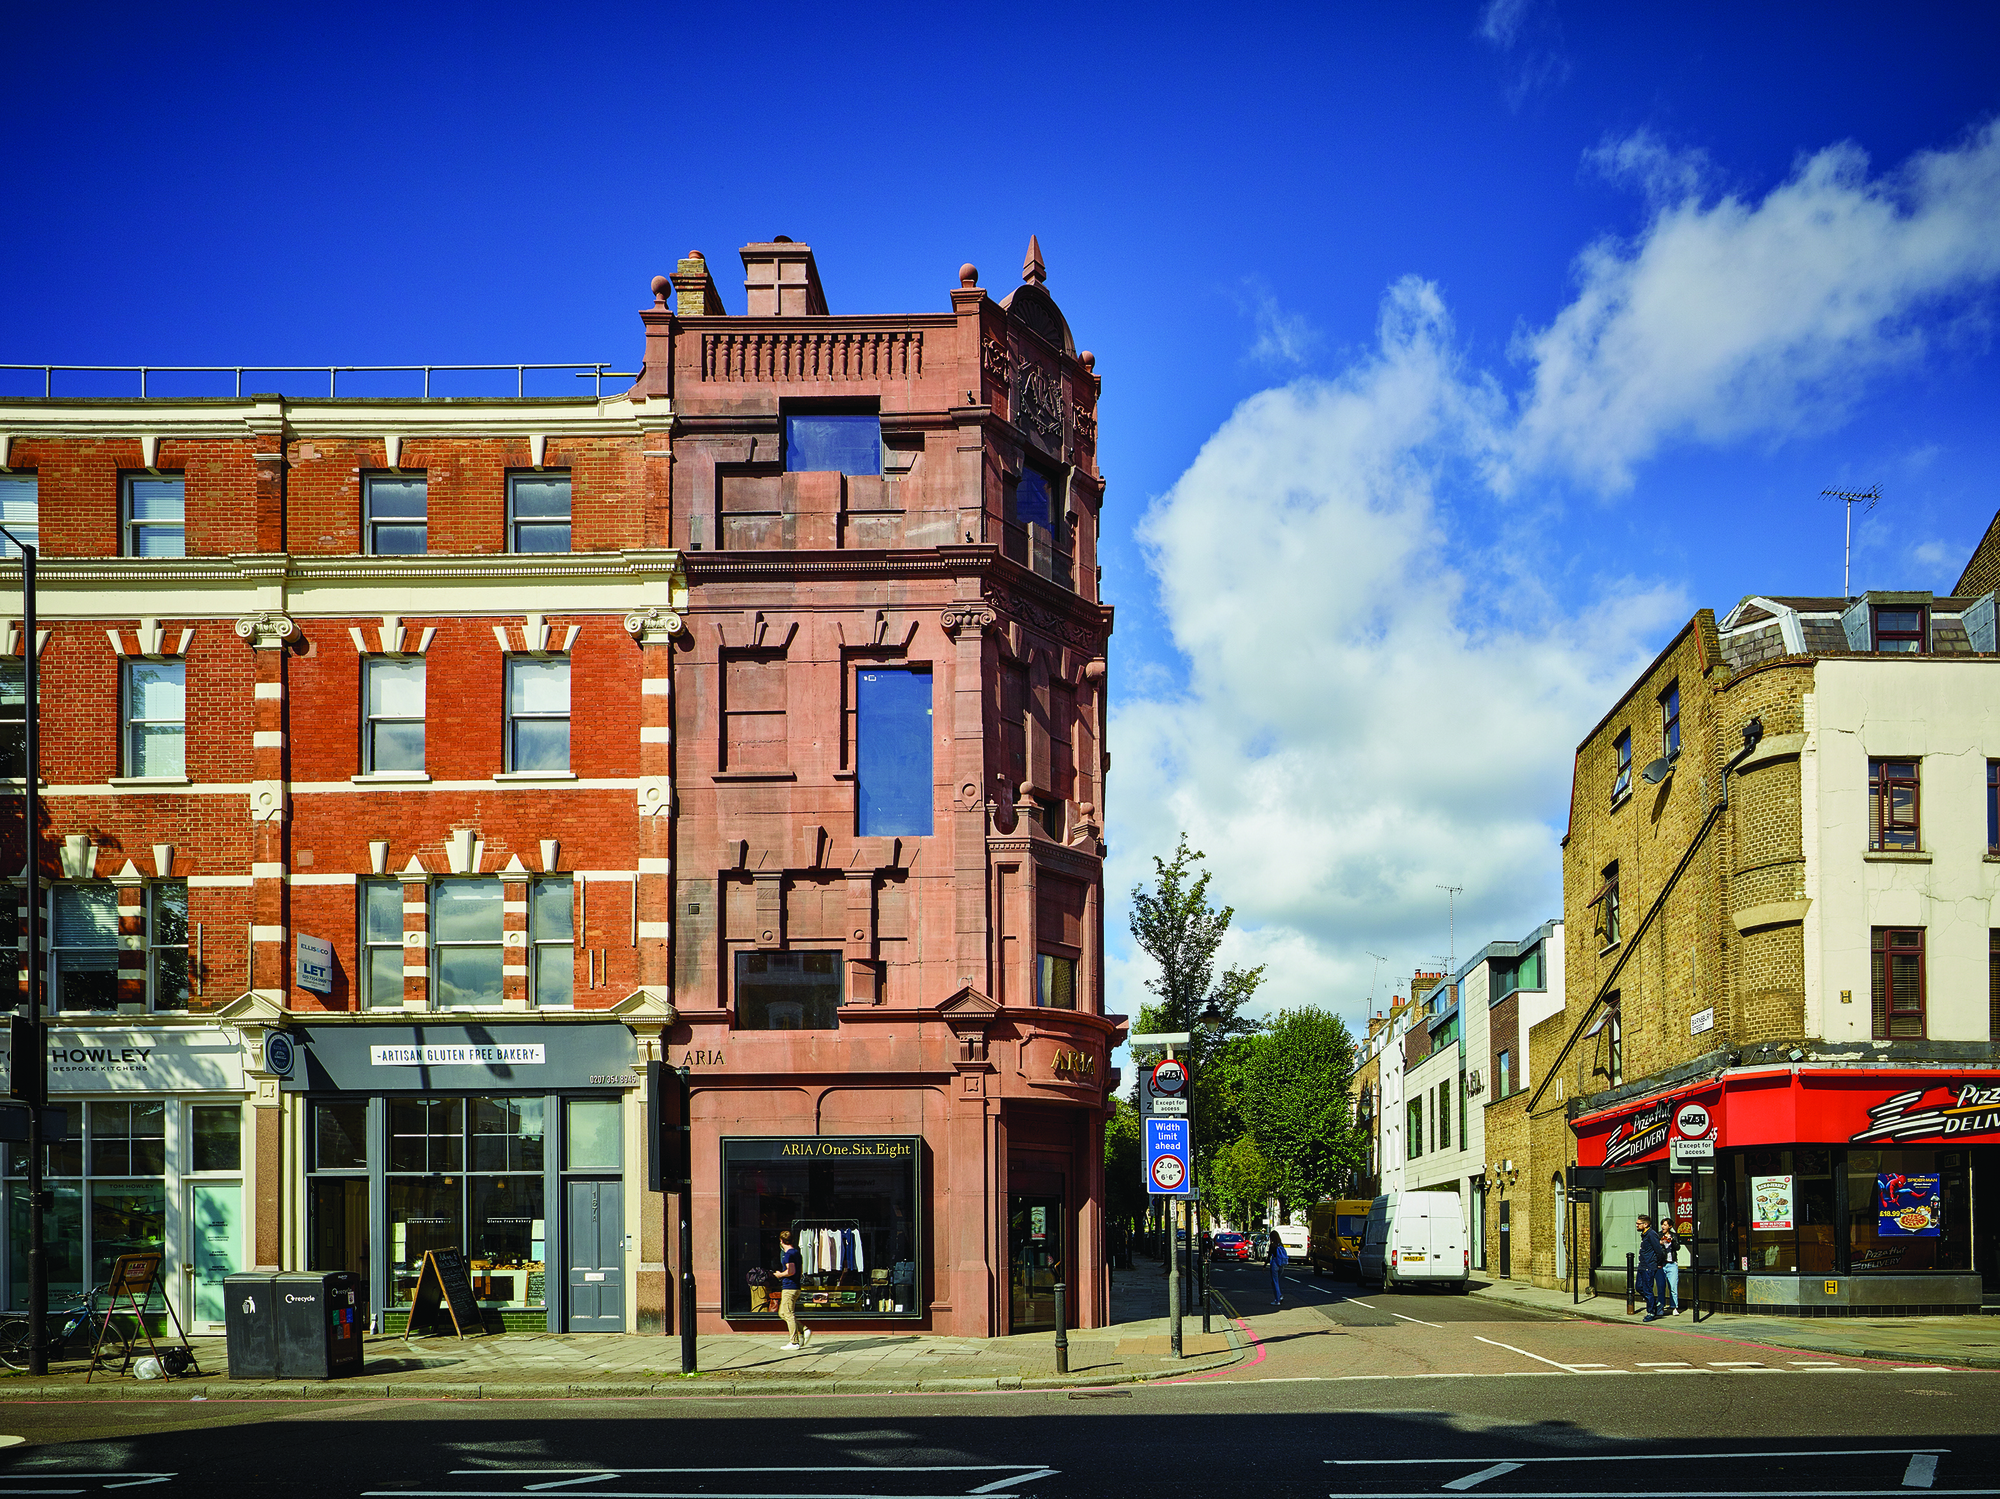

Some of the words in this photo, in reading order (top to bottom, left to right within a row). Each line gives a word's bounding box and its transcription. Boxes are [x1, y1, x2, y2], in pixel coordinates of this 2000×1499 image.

[301, 943, 329, 956] ELLIS&CO
[304, 963, 326, 977] LET
[1692, 1013, 1712, 1026] BARNSBURY
[52, 1049, 151, 1063] HOWLEY
[427, 1050, 465, 1061] GLUTEN
[470, 1049, 493, 1060] FREE
[682, 1049, 727, 1066] ARIA
[1050, 1048, 1096, 1075] ARIA
[590, 1075, 605, 1085] 0207
[606, 1075, 619, 1084] 354
[1632, 1113, 1655, 1135] Pizza
[1654, 1102, 1673, 1121] Hut
[1155, 1123, 1181, 1131] Width
[1158, 1132, 1178, 1141] limit
[1629, 1126, 1668, 1157] DELIVERY
[1155, 1142, 1181, 1150] ahead
[1865, 1249, 1889, 1260] Pizza
[1889, 1246, 1906, 1255] Hut
[1860, 1257, 1902, 1270] DELIVERY
[294, 1295, 316, 1303] recycle
